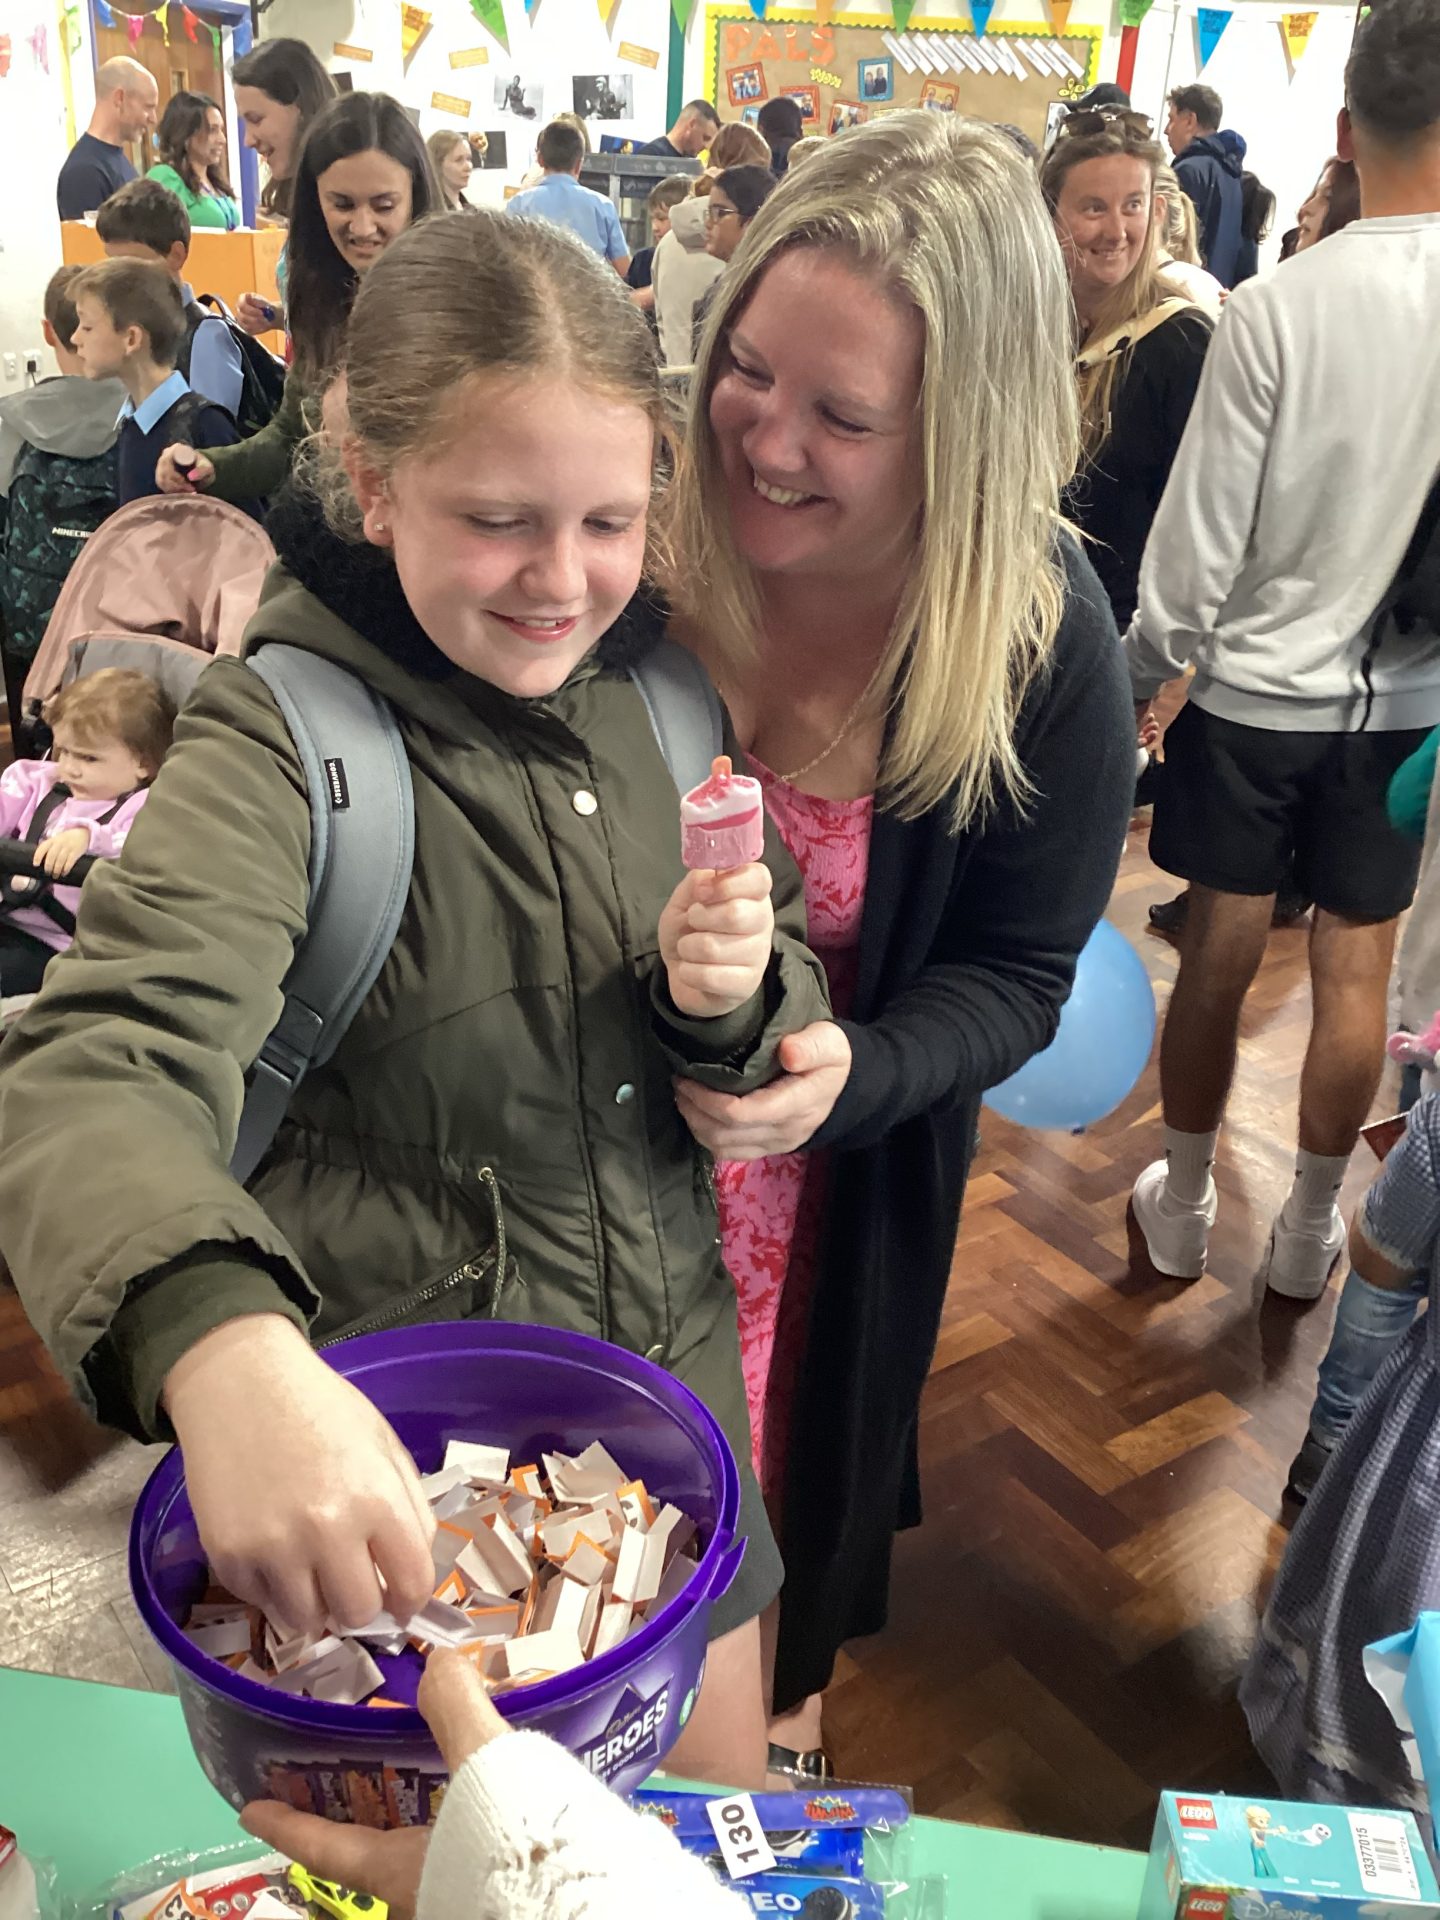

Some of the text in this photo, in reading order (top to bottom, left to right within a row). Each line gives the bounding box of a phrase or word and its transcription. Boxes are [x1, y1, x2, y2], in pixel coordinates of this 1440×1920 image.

[725, 23, 835, 66] PALS
[52, 527, 90, 538] MINECR
[1180, 1805, 1213, 1820] LEGO
[721, 1803, 760, 1863] 130
[1356, 1827, 1377, 1877] 03377015
[751, 1892, 802, 1912] EO
[1190, 1898, 1224, 1913] LEGO
